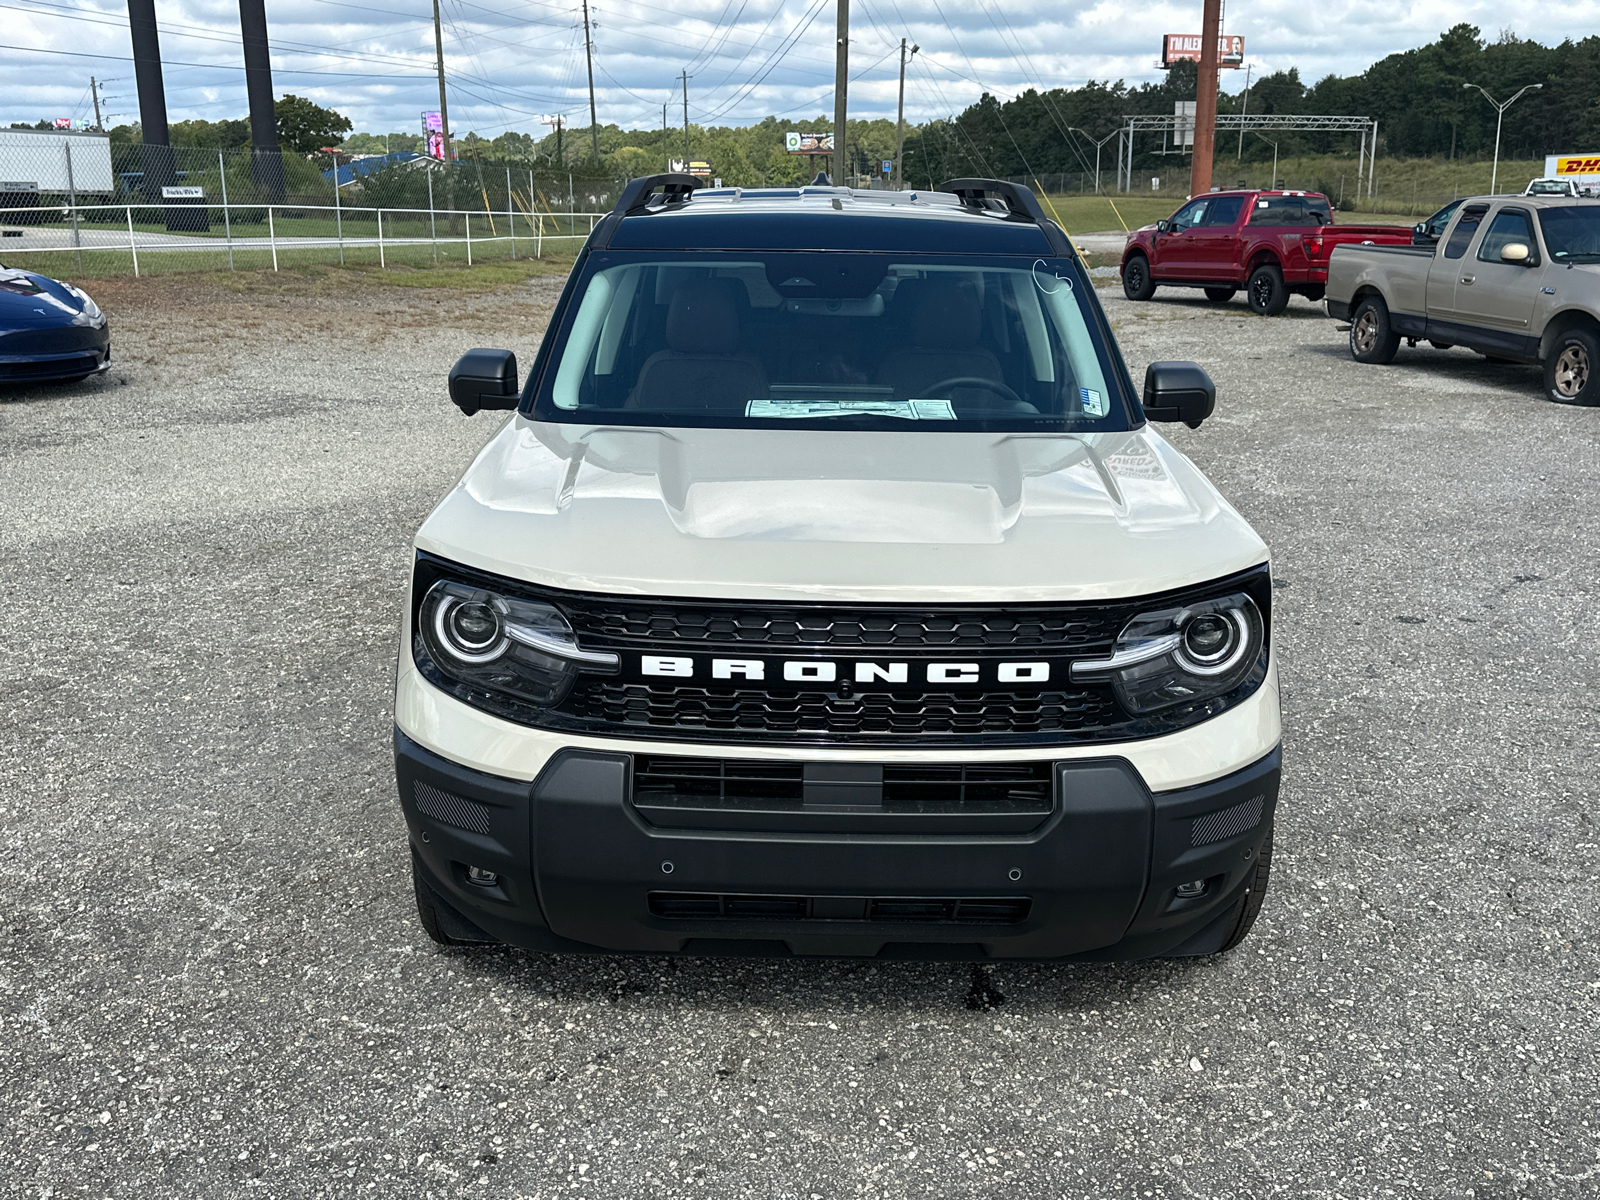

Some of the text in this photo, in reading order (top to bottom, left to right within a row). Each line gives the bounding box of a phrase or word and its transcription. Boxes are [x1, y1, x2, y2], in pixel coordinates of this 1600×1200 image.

[1169, 36, 1181, 51] I'M
[1565, 160, 1600, 172] DH
[641, 655, 1050, 683] BRONCO
